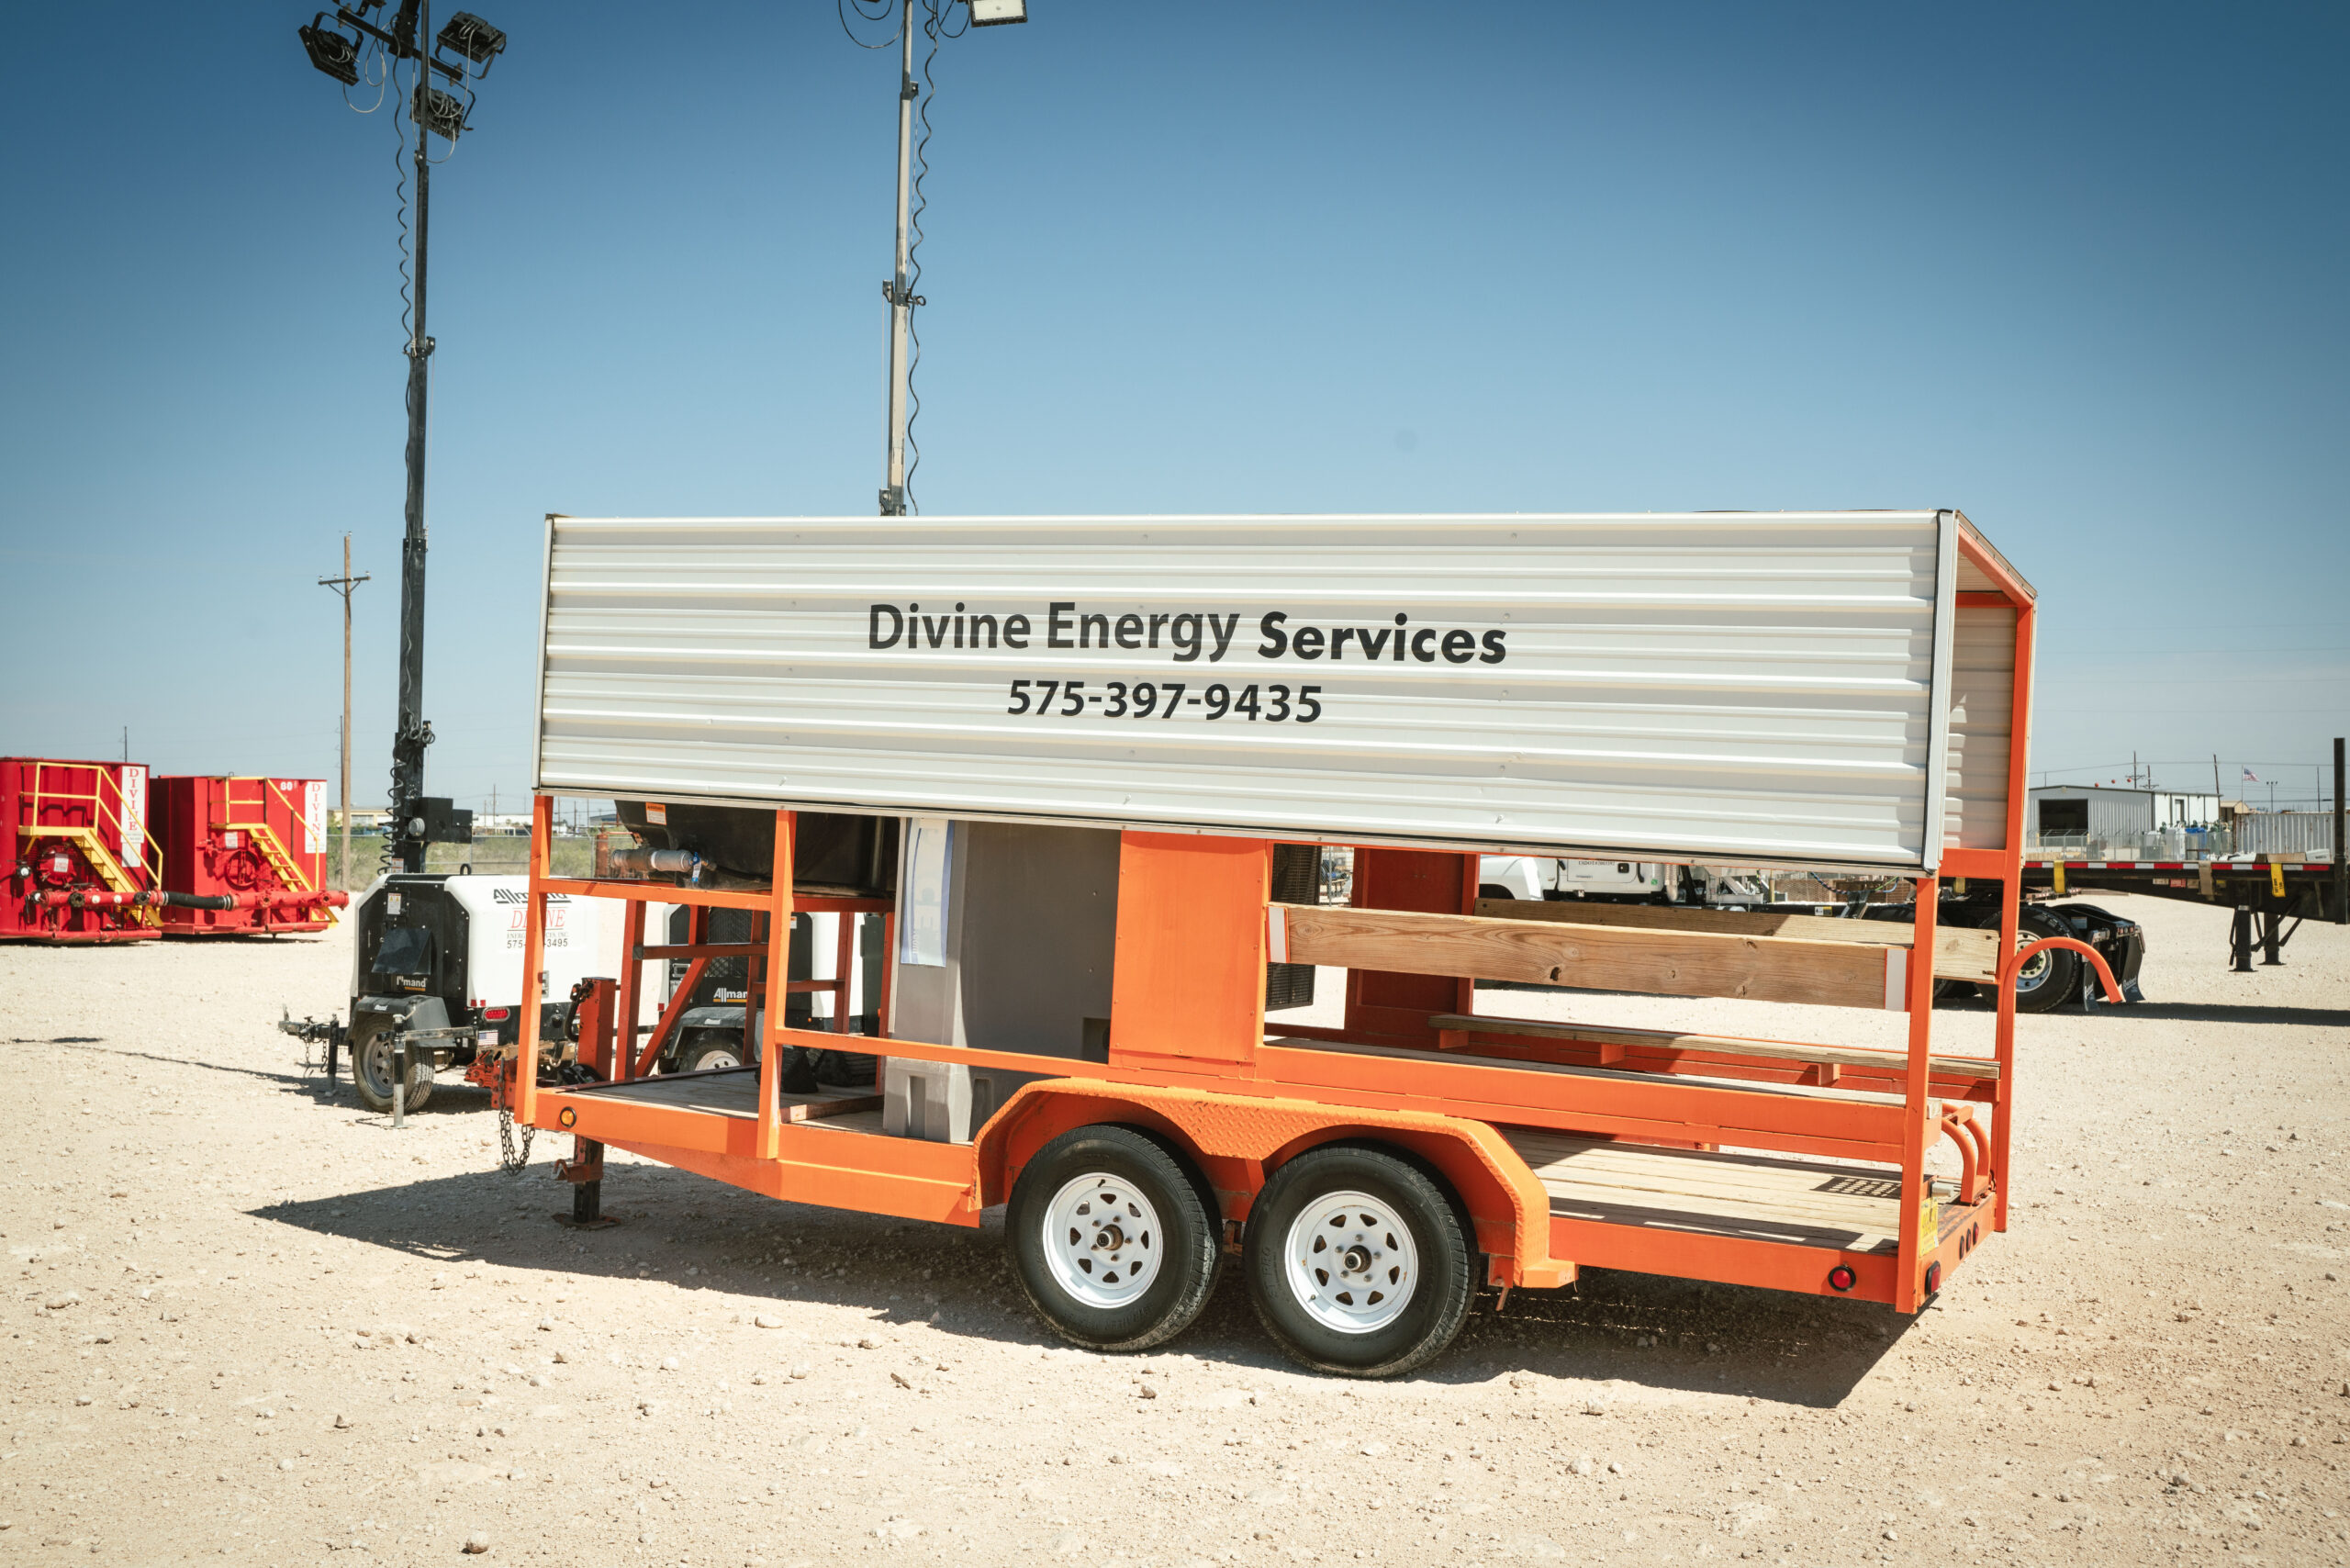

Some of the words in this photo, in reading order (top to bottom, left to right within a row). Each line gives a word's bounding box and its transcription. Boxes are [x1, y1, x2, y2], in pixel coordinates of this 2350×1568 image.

[869, 602, 1031, 649] Divine
[1048, 602, 1240, 661] Energy
[1259, 611, 1506, 664] Services
[1008, 680, 1321, 722] 575-397-9435
[128, 767, 140, 831] DIVINE
[510, 909, 565, 928] DINE
[507, 938, 568, 948] 575--3495
[713, 987, 748, 1003] Allman
